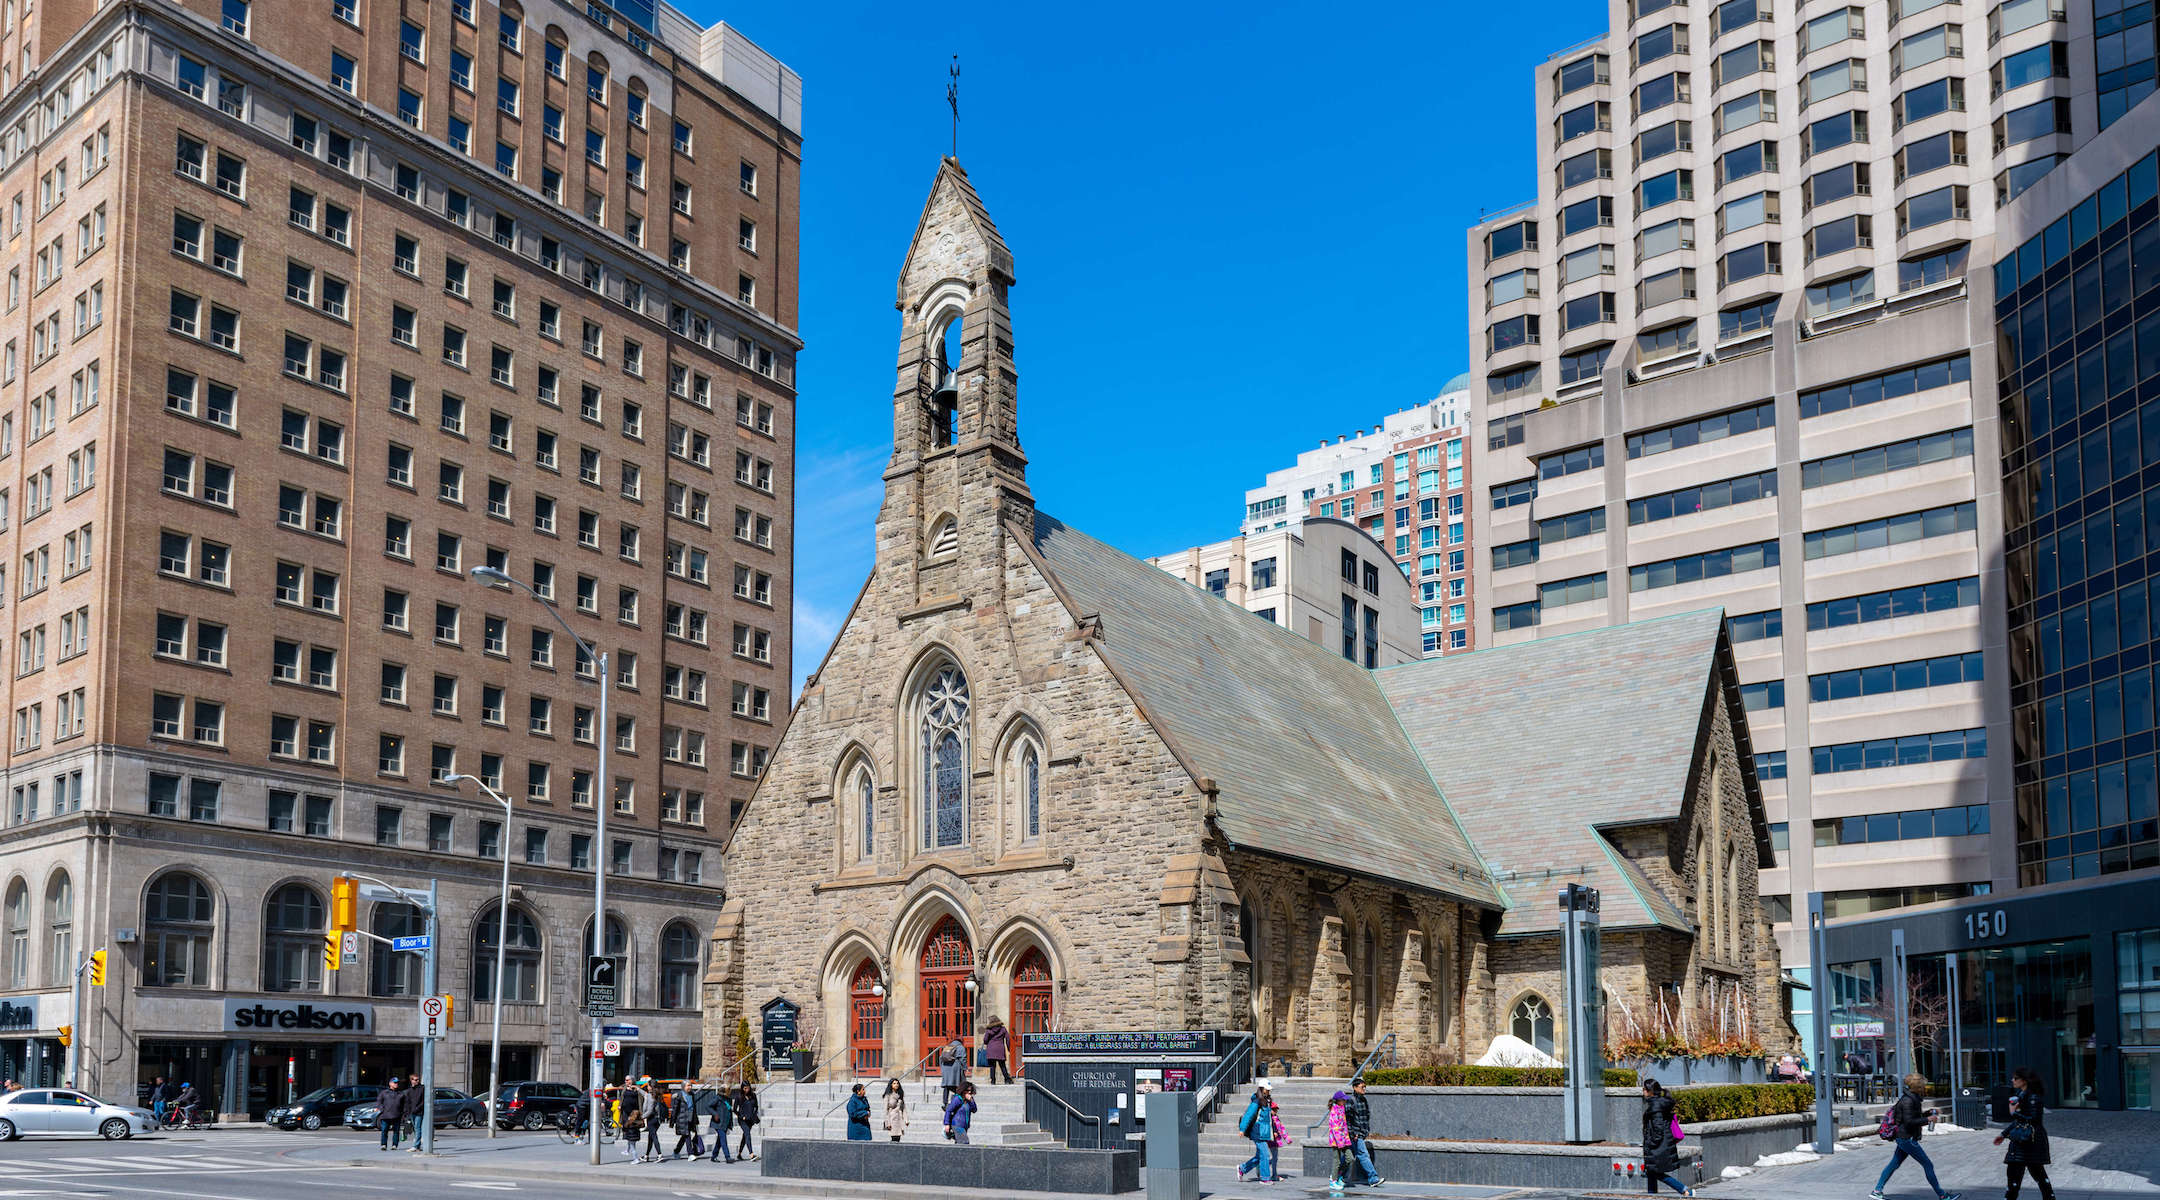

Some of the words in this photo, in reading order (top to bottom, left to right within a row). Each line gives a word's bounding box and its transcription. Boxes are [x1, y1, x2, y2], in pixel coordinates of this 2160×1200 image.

[1965, 910, 2007, 940] 150
[400, 938, 417, 947] Bloor
[421, 937, 428, 946] W
[0, 1001, 33, 1025] llson
[235, 1004, 365, 1030] strellson
[1030, 1034, 1060, 1042] BLUEGRASS
[1061, 1034, 1091, 1042] EUCHARIST
[1095, 1034, 1118, 1042] SUNDAY
[1156, 1033, 1190, 1041] FEATURING:
[1141, 1041, 1149, 1049] BY
[1149, 1041, 1168, 1049] CAROL
[1169, 1041, 1197, 1049] BARNETT
[1072, 1072, 1105, 1080] CHURCH
[1106, 1072, 1117, 1080] OF
[1072, 1080, 1087, 1088] THE
[1089, 1080, 1127, 1088] REDEEMER
